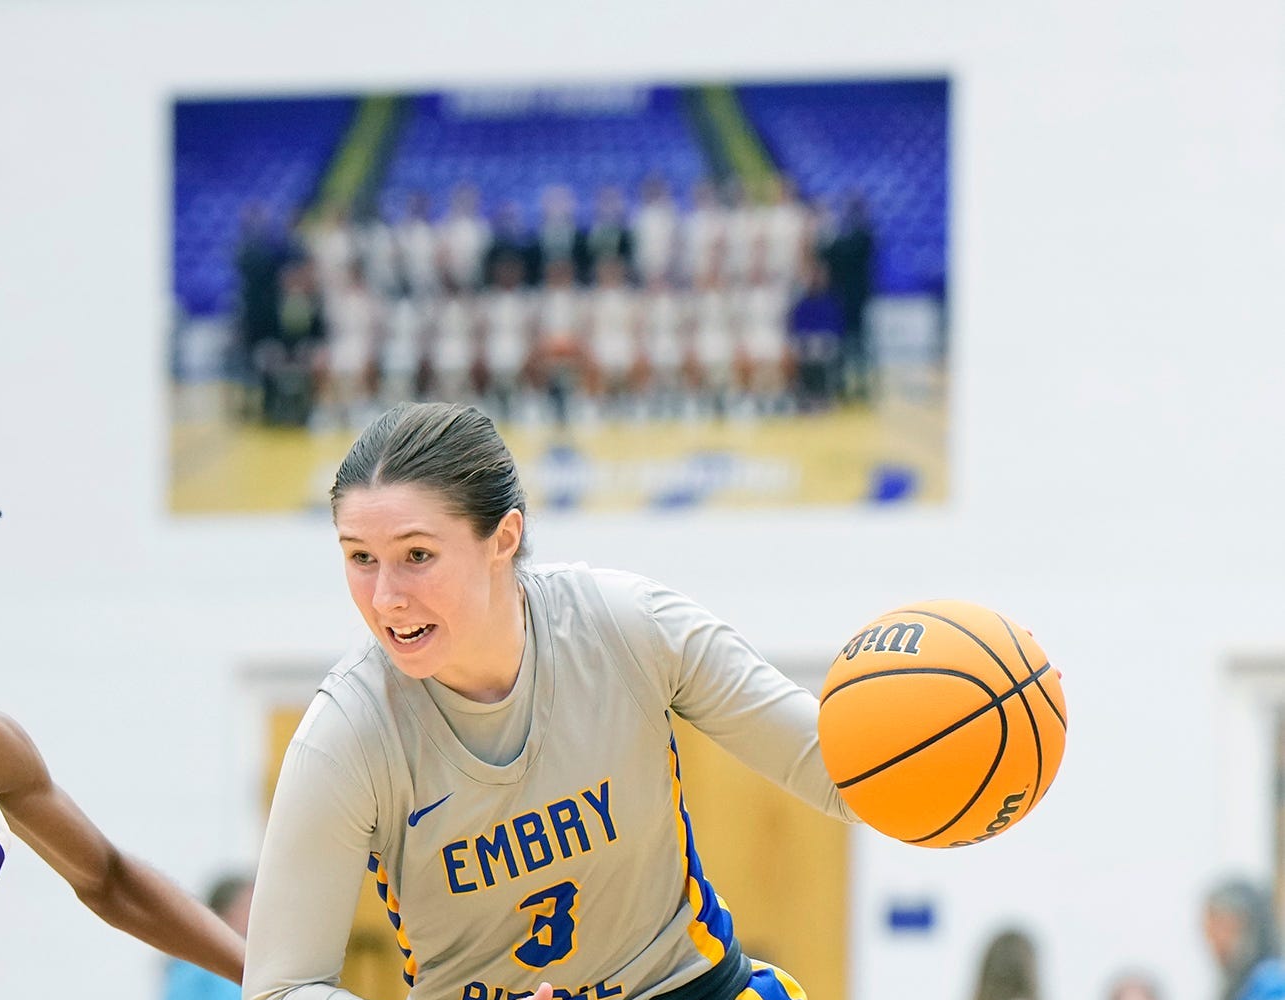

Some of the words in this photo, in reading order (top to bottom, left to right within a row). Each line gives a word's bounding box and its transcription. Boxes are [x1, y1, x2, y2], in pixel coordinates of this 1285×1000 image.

[843, 622, 926, 661] Wil
[440, 778, 618, 895] EMBRY
[512, 878, 581, 971] 3
